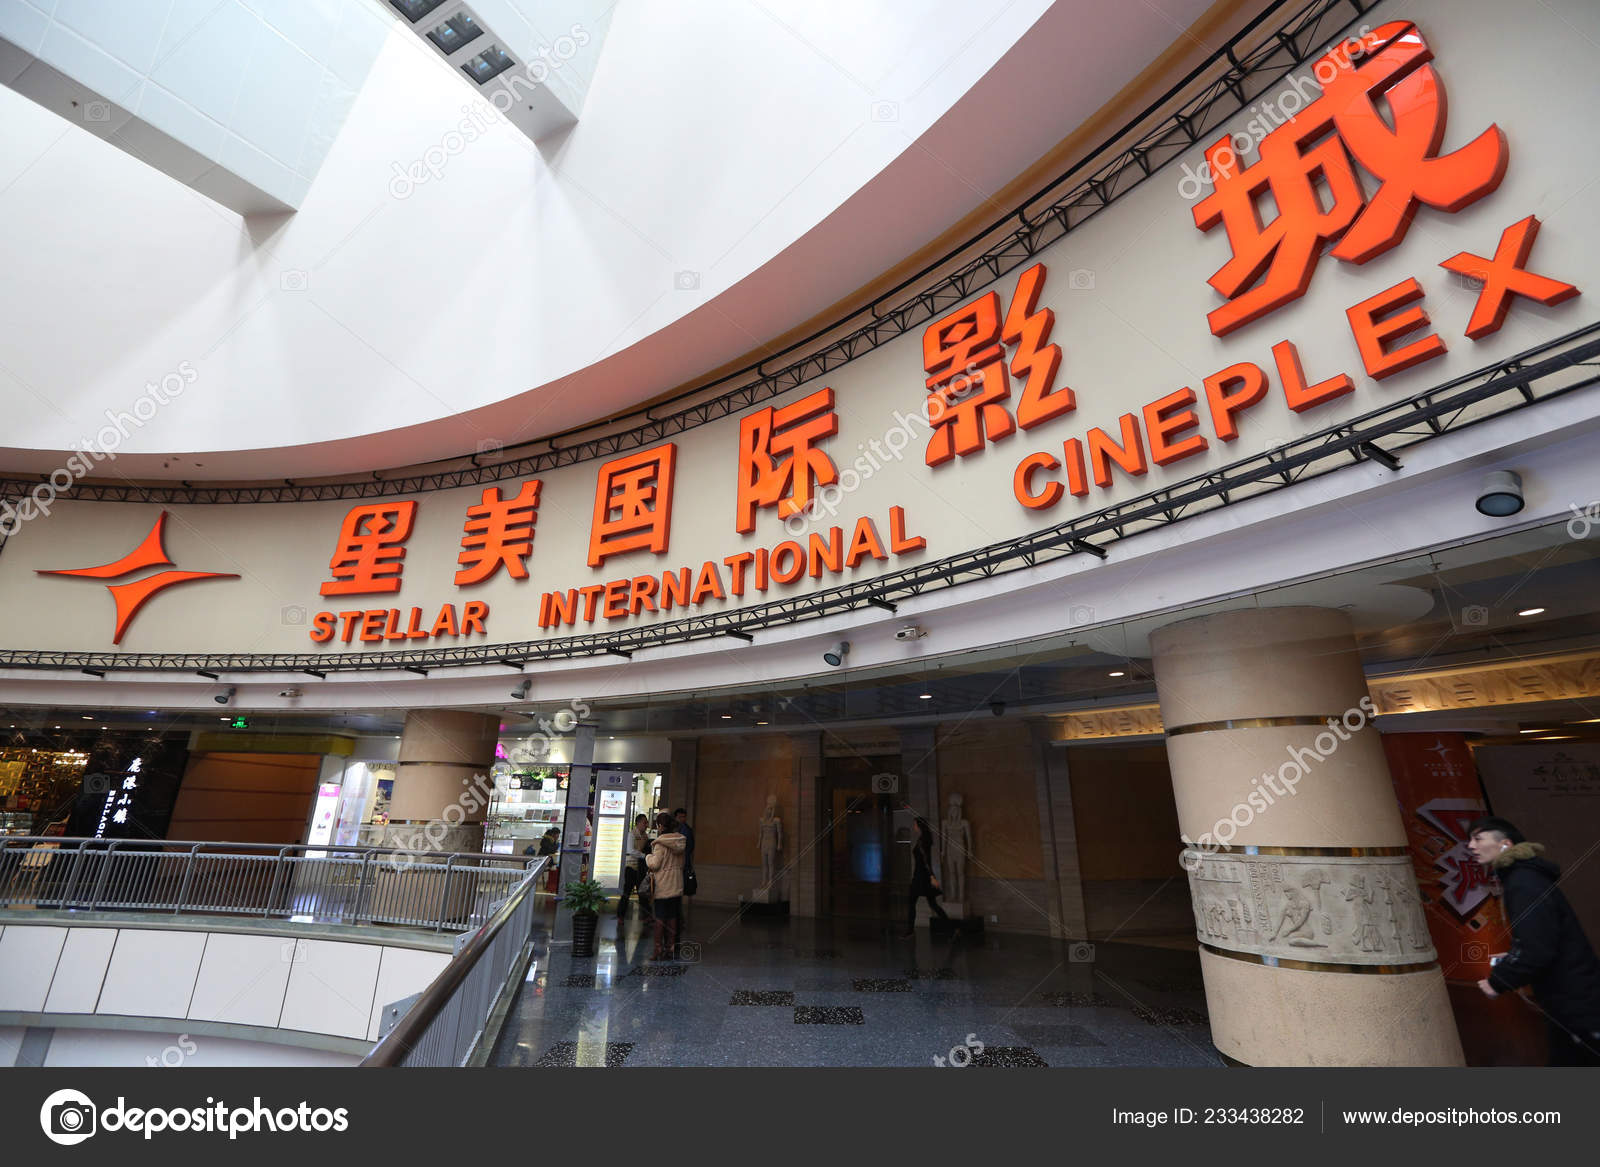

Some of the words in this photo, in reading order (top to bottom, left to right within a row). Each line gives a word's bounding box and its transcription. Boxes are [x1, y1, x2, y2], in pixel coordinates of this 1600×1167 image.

[309, 600, 490, 642] STELLAR
[538, 505, 927, 629] INTERNATIONAL
[1012, 214, 1582, 510] CINEPLEX
